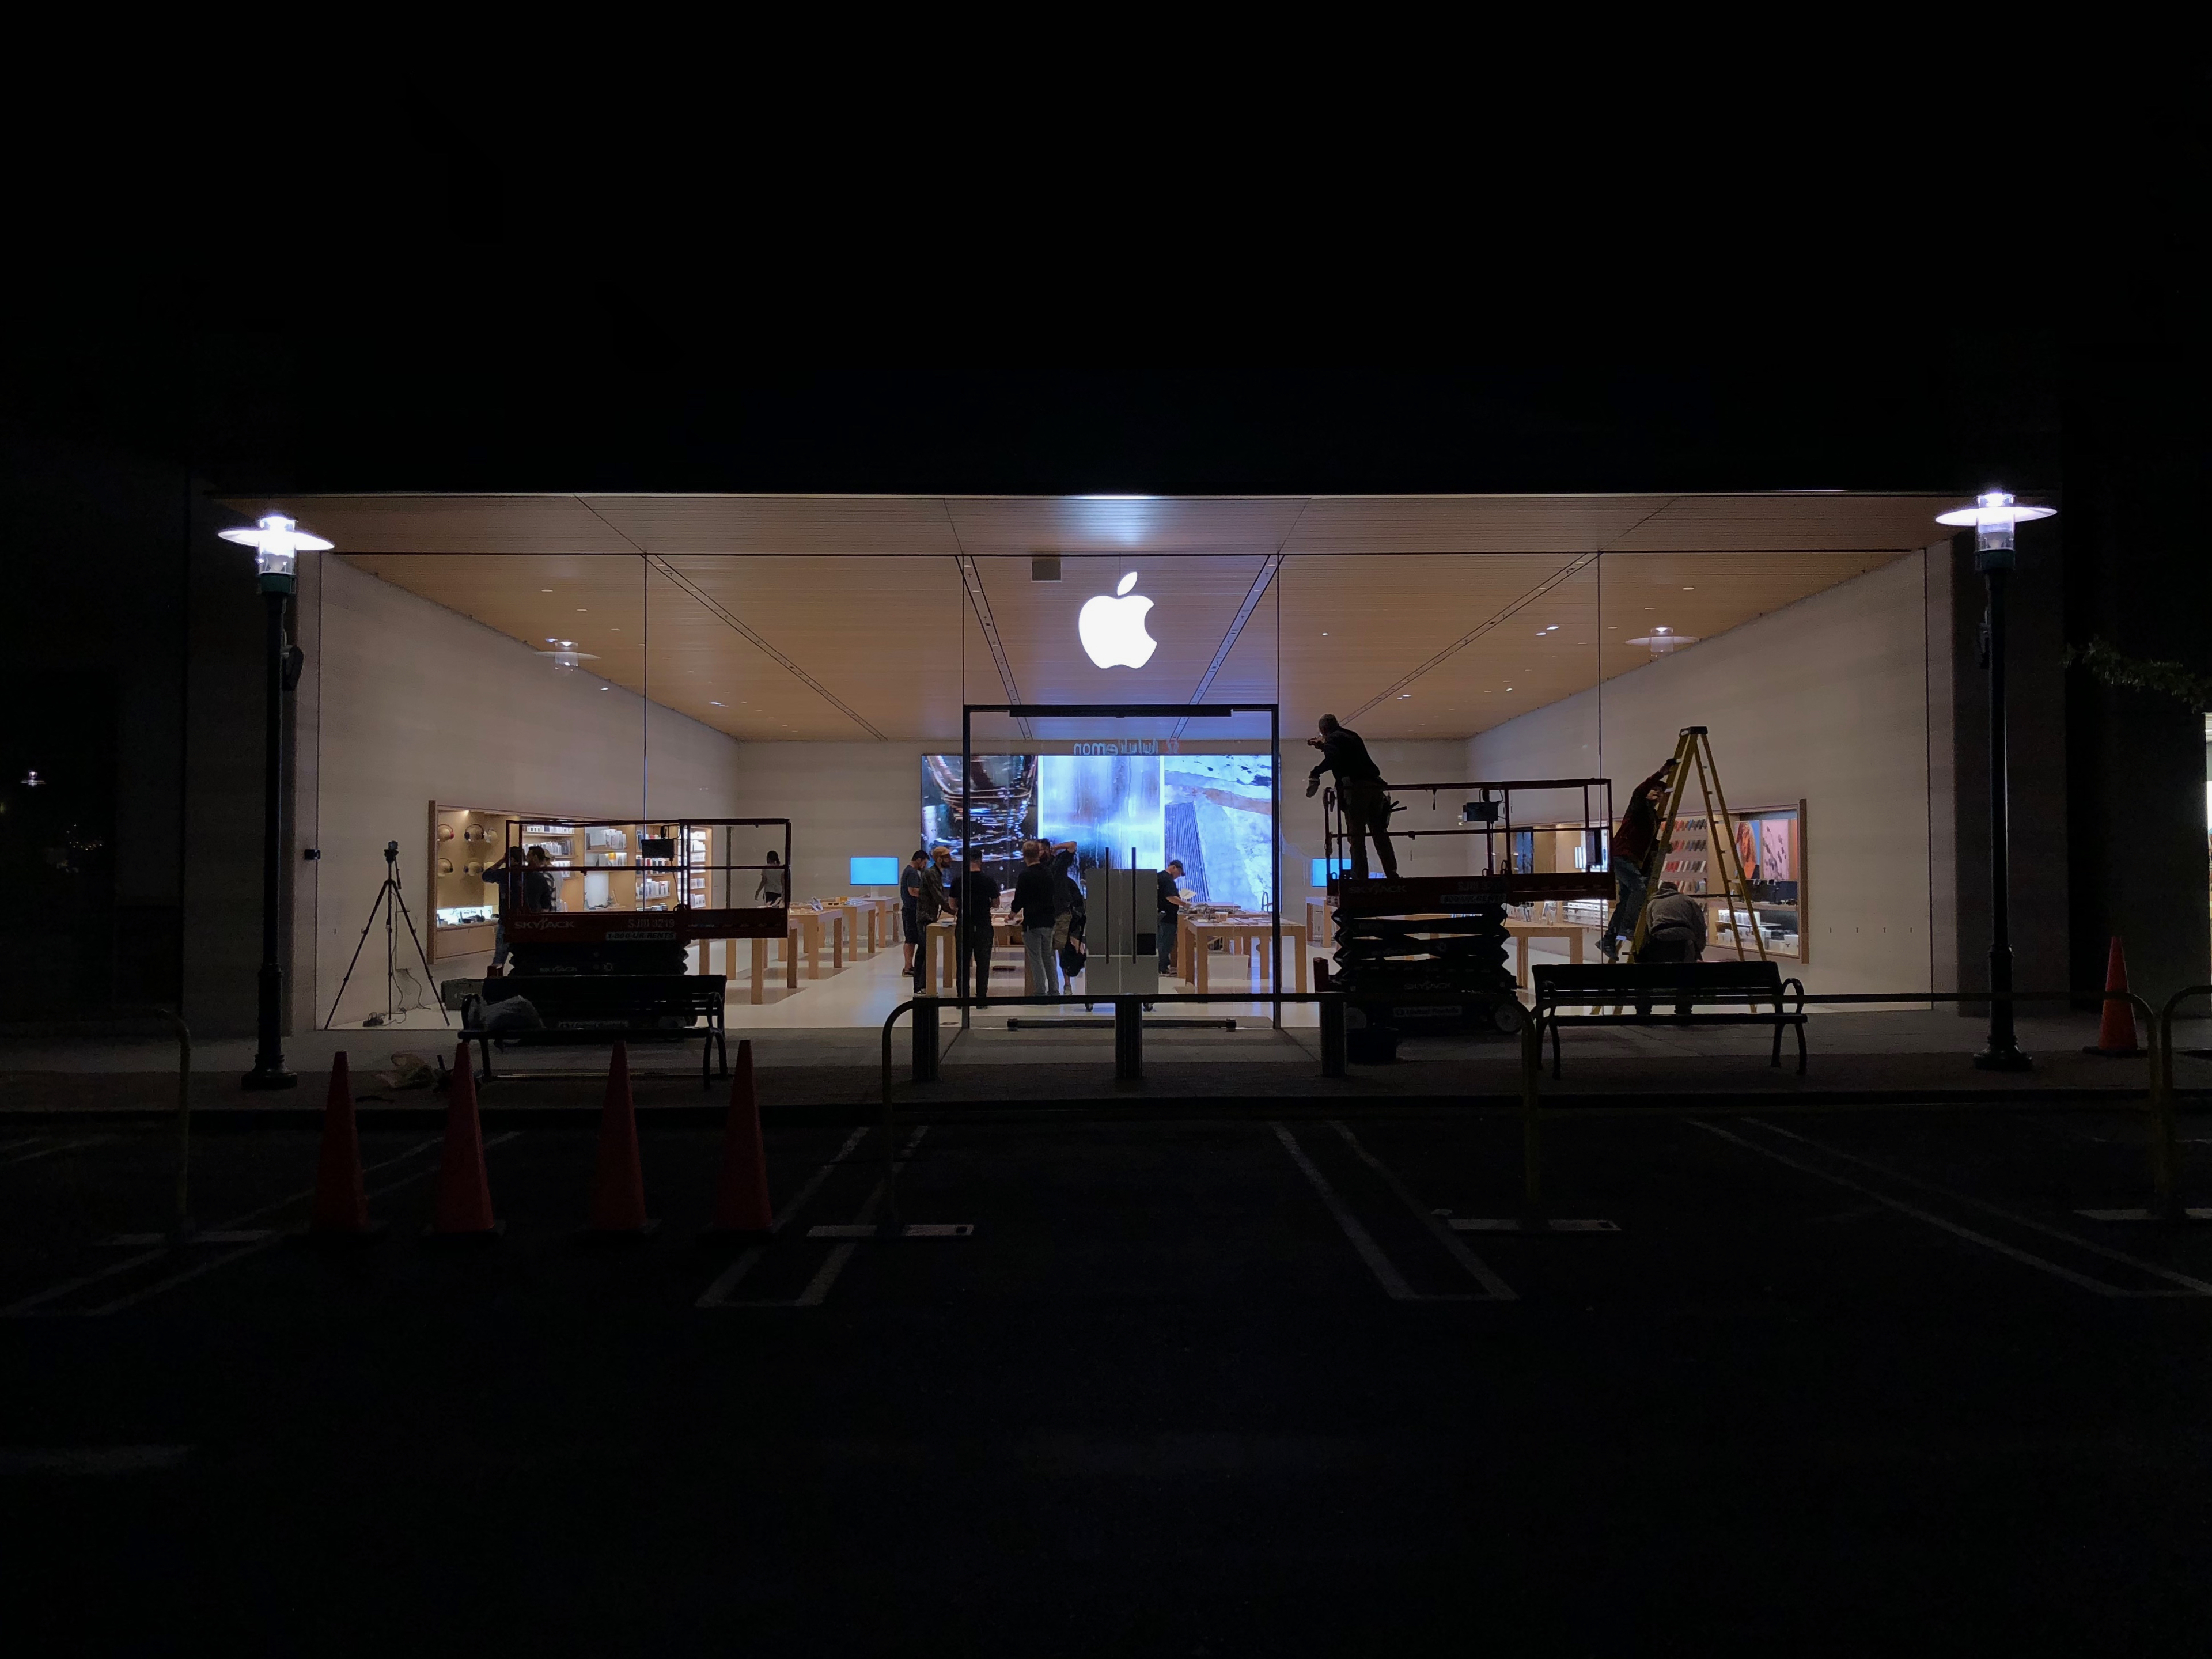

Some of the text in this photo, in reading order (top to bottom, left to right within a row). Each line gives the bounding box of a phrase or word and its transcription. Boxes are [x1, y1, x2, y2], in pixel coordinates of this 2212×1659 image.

[1349, 882, 1407, 895] SKYJACK
[514, 917, 575, 930] SKYJACK
[652, 918, 675, 929] 3219
